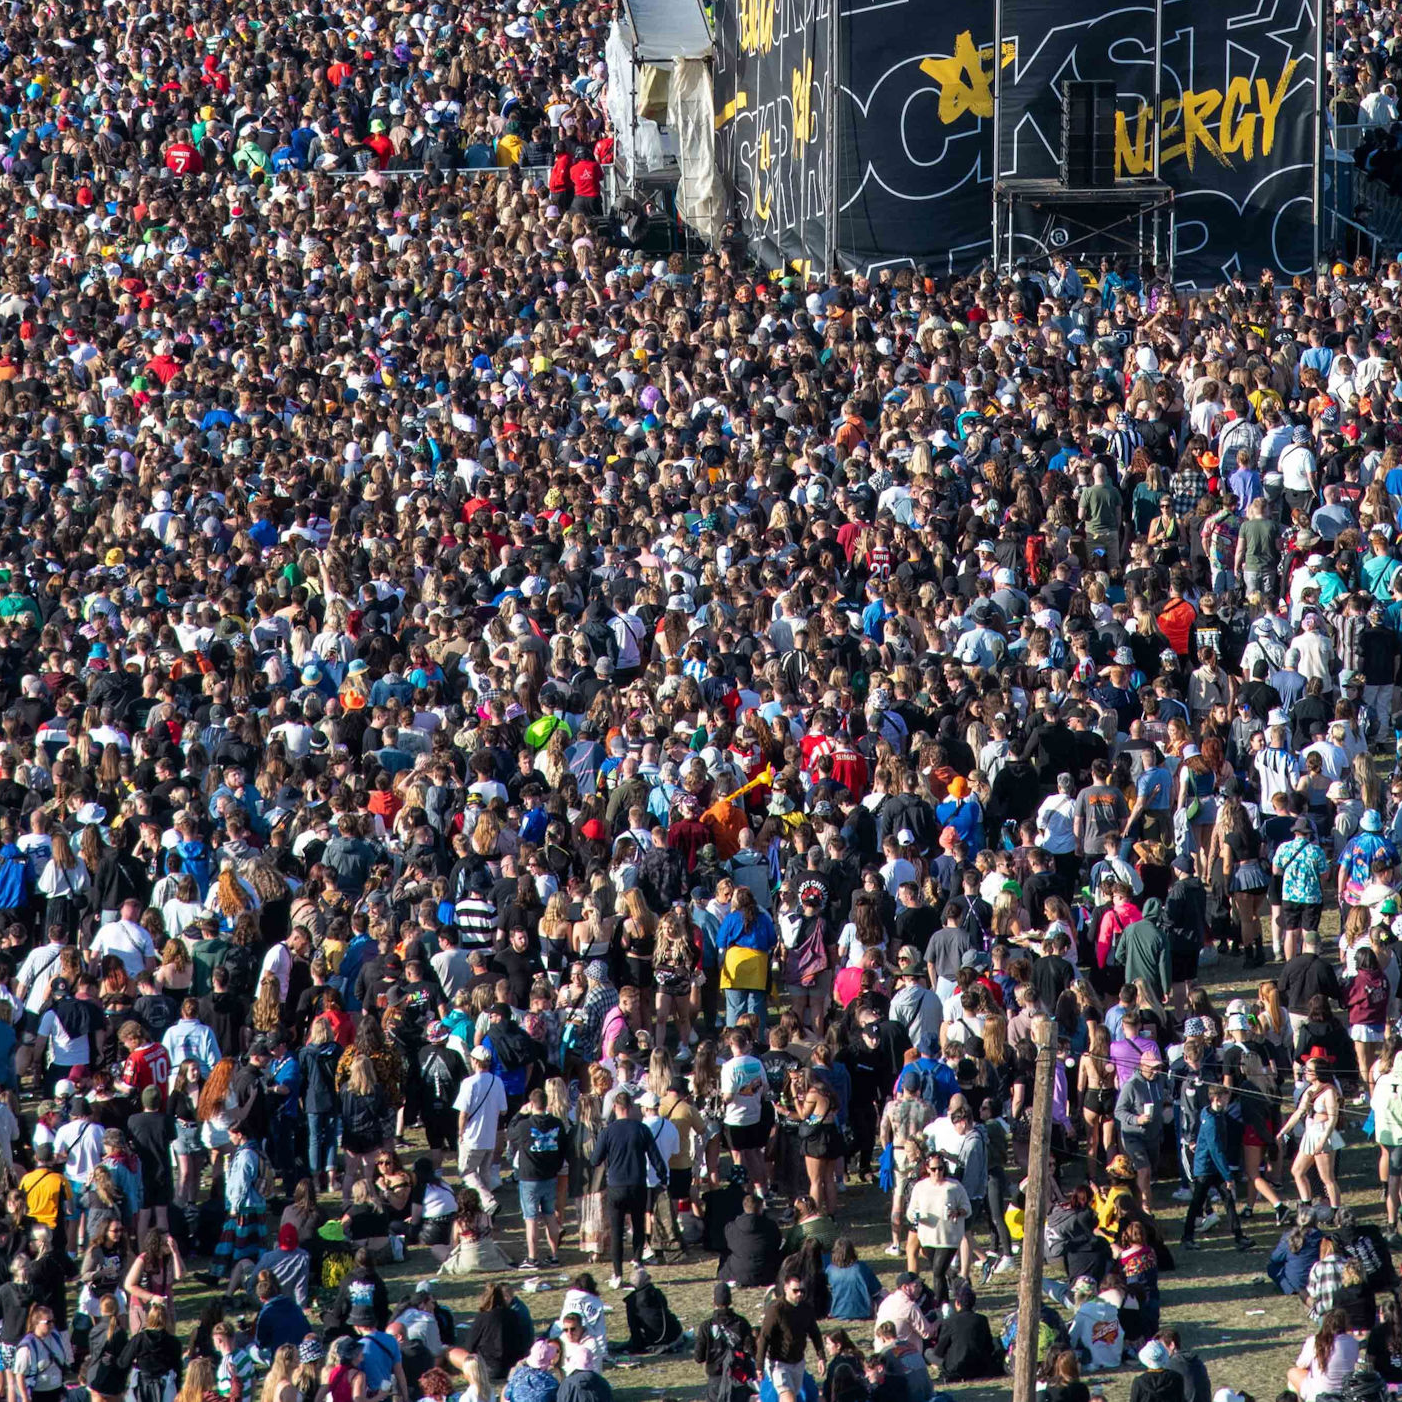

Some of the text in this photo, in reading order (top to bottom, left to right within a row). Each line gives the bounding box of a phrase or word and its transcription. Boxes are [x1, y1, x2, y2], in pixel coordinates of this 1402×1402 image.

[1114, 59, 1298, 174] NERGY
[870, 562, 891, 583] 20
[149, 1057, 168, 1085] 10
